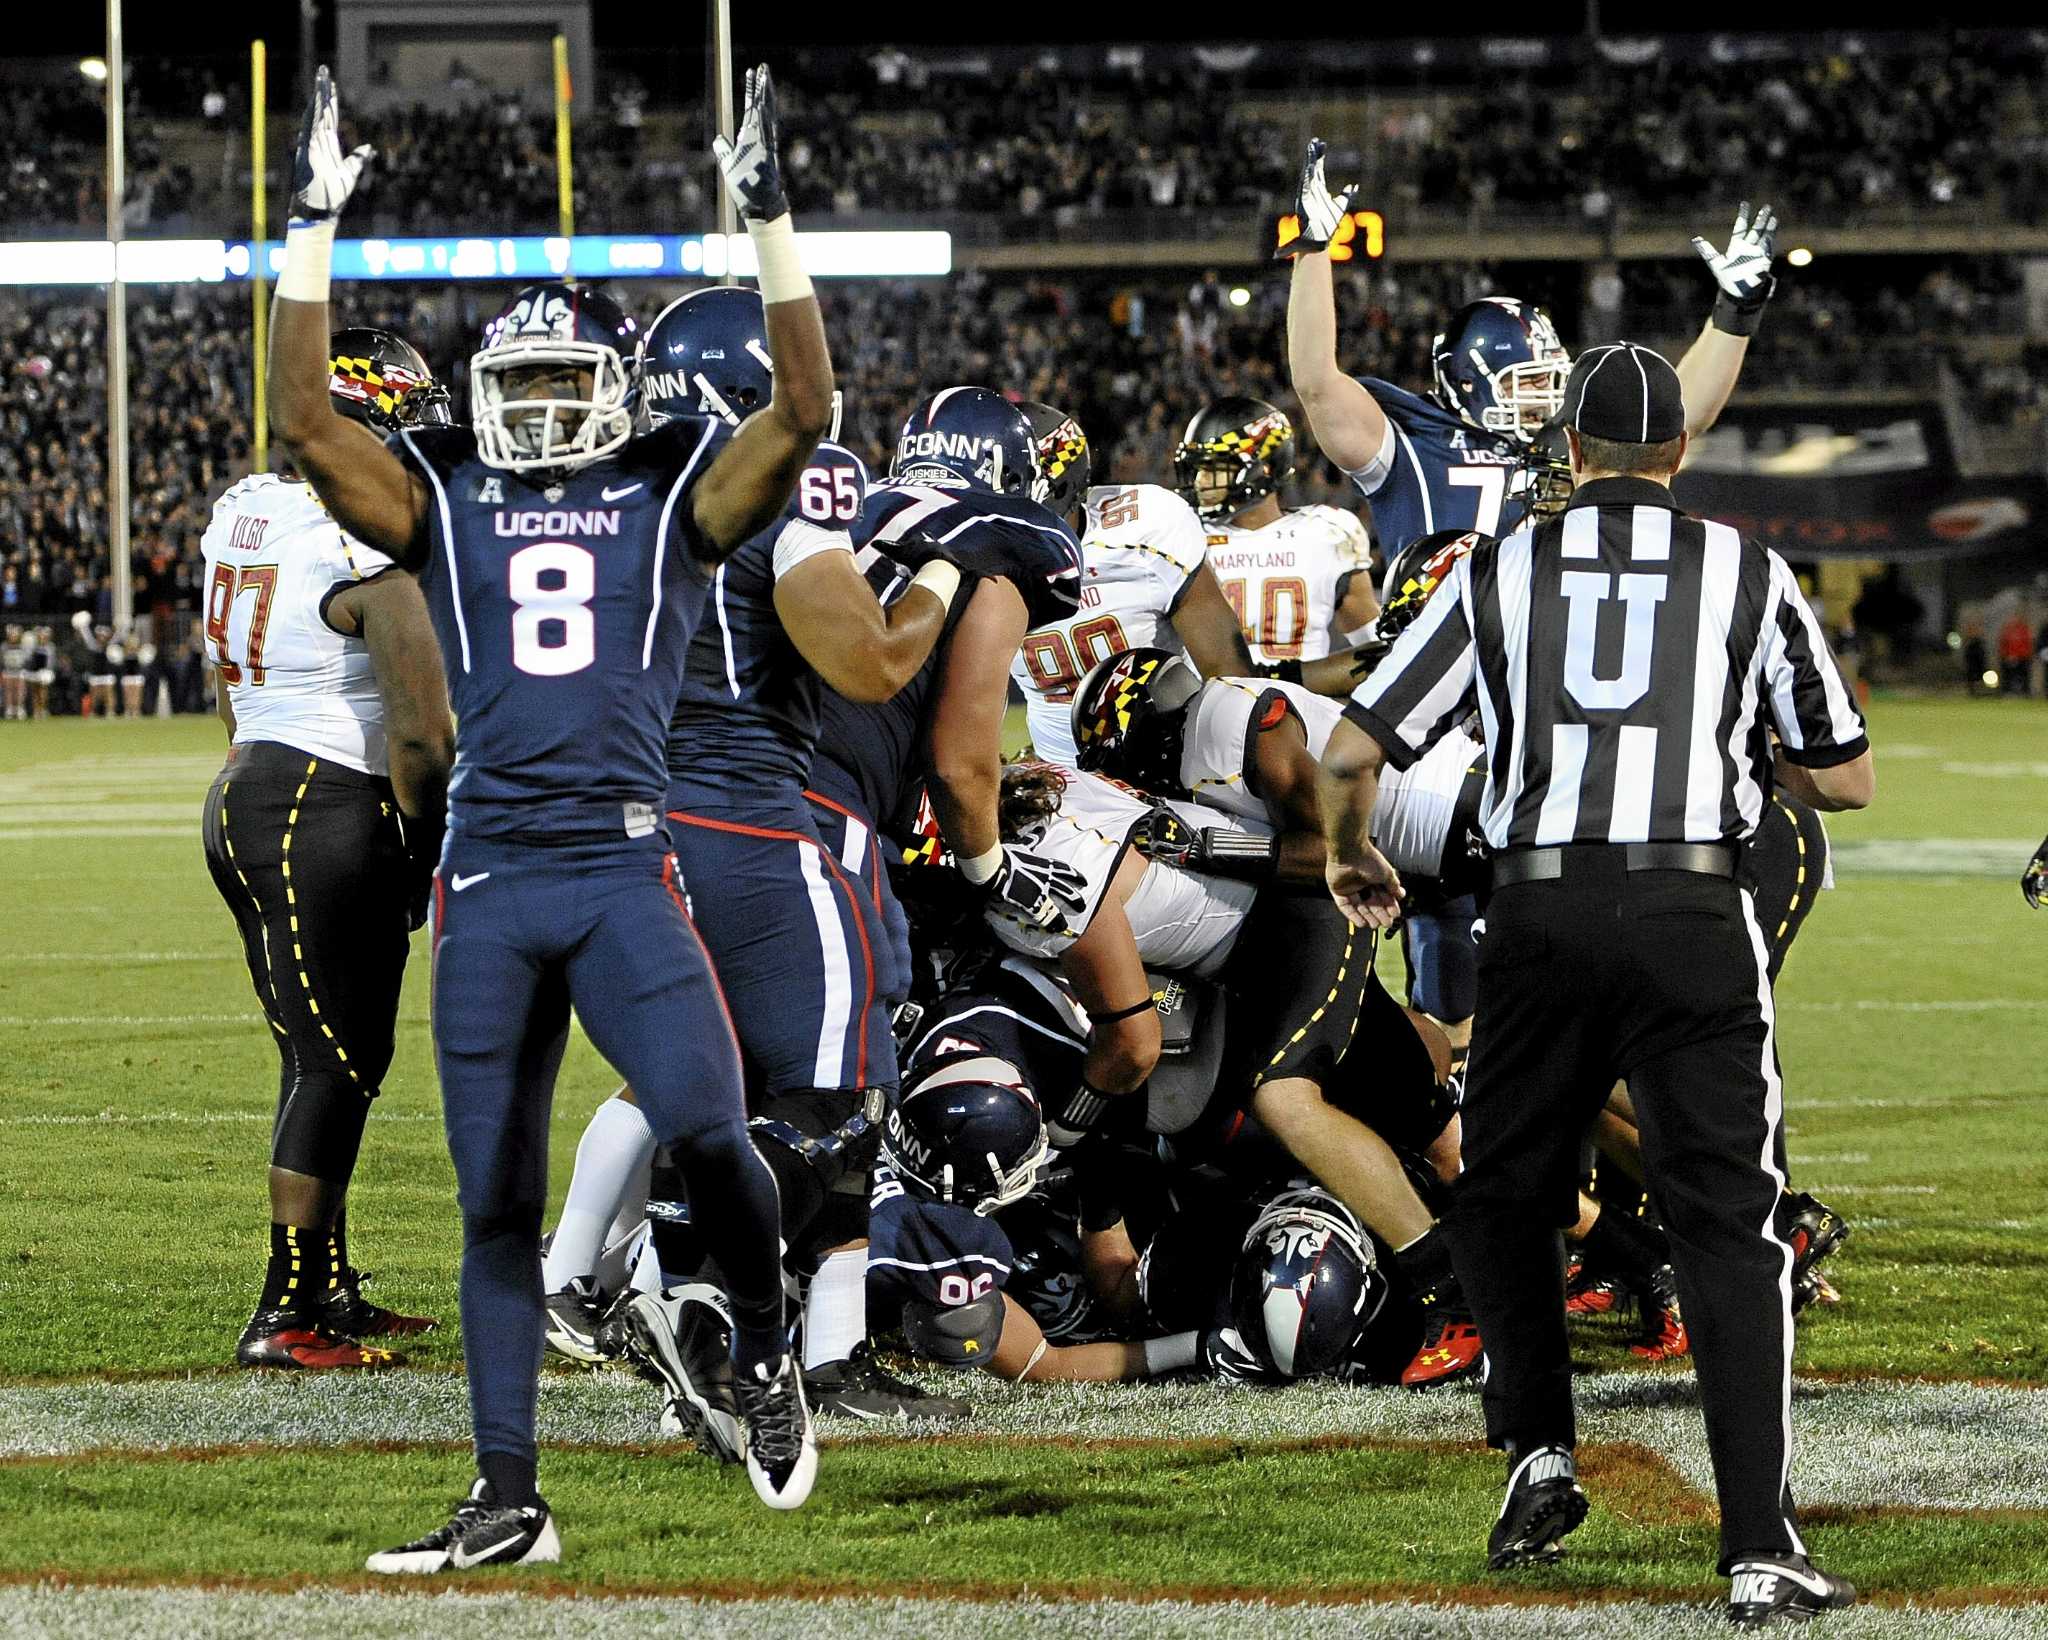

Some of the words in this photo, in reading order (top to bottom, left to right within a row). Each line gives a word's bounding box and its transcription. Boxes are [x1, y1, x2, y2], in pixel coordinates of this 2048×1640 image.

[799, 468, 859, 520] 65
[905, 468, 948, 479] HUSKIES
[228, 514, 270, 551] KILGO
[494, 510, 621, 537] UCONN
[1213, 551, 1296, 570] MARYLAND
[207, 560, 279, 687] 97
[509, 541, 596, 677] 8
[1560, 570, 1668, 710] U
